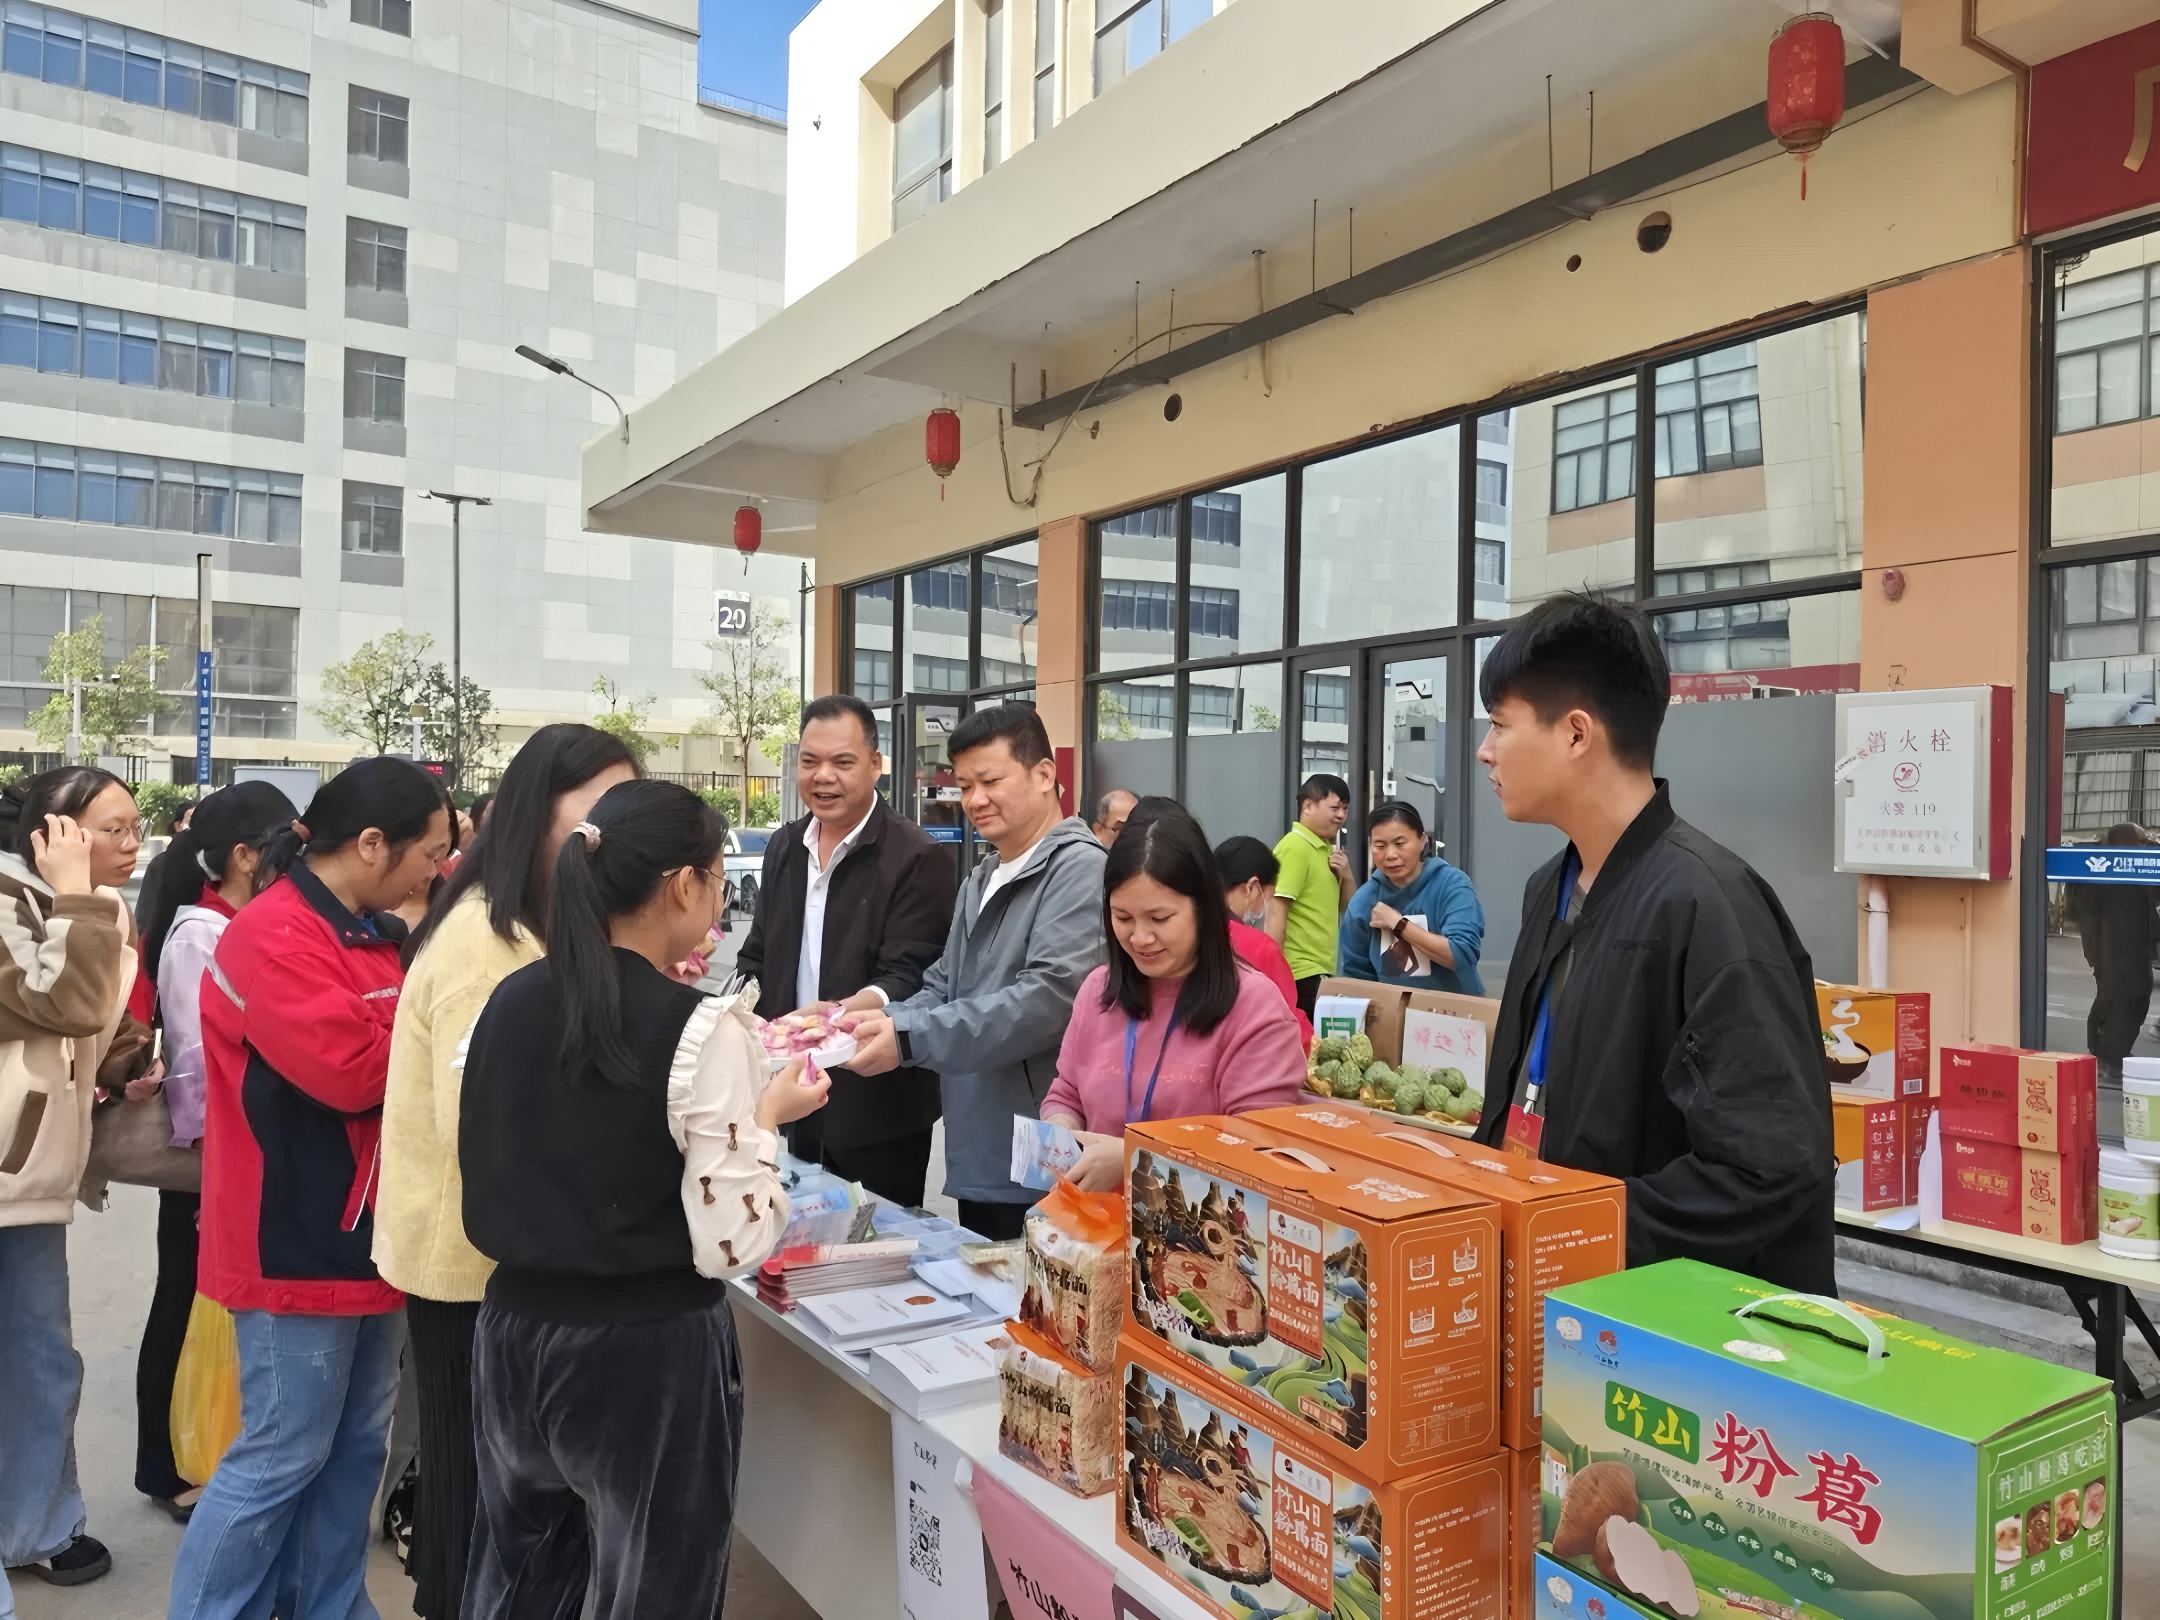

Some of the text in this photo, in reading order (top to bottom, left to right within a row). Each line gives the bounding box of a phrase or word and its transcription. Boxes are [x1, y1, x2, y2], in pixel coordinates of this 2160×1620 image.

[719, 606, 747, 629] 20
[1867, 728, 1951, 753] 消火栓
[1612, 1386, 1690, 1454] 竹山
[1705, 1411, 1882, 1545] 粉葛
